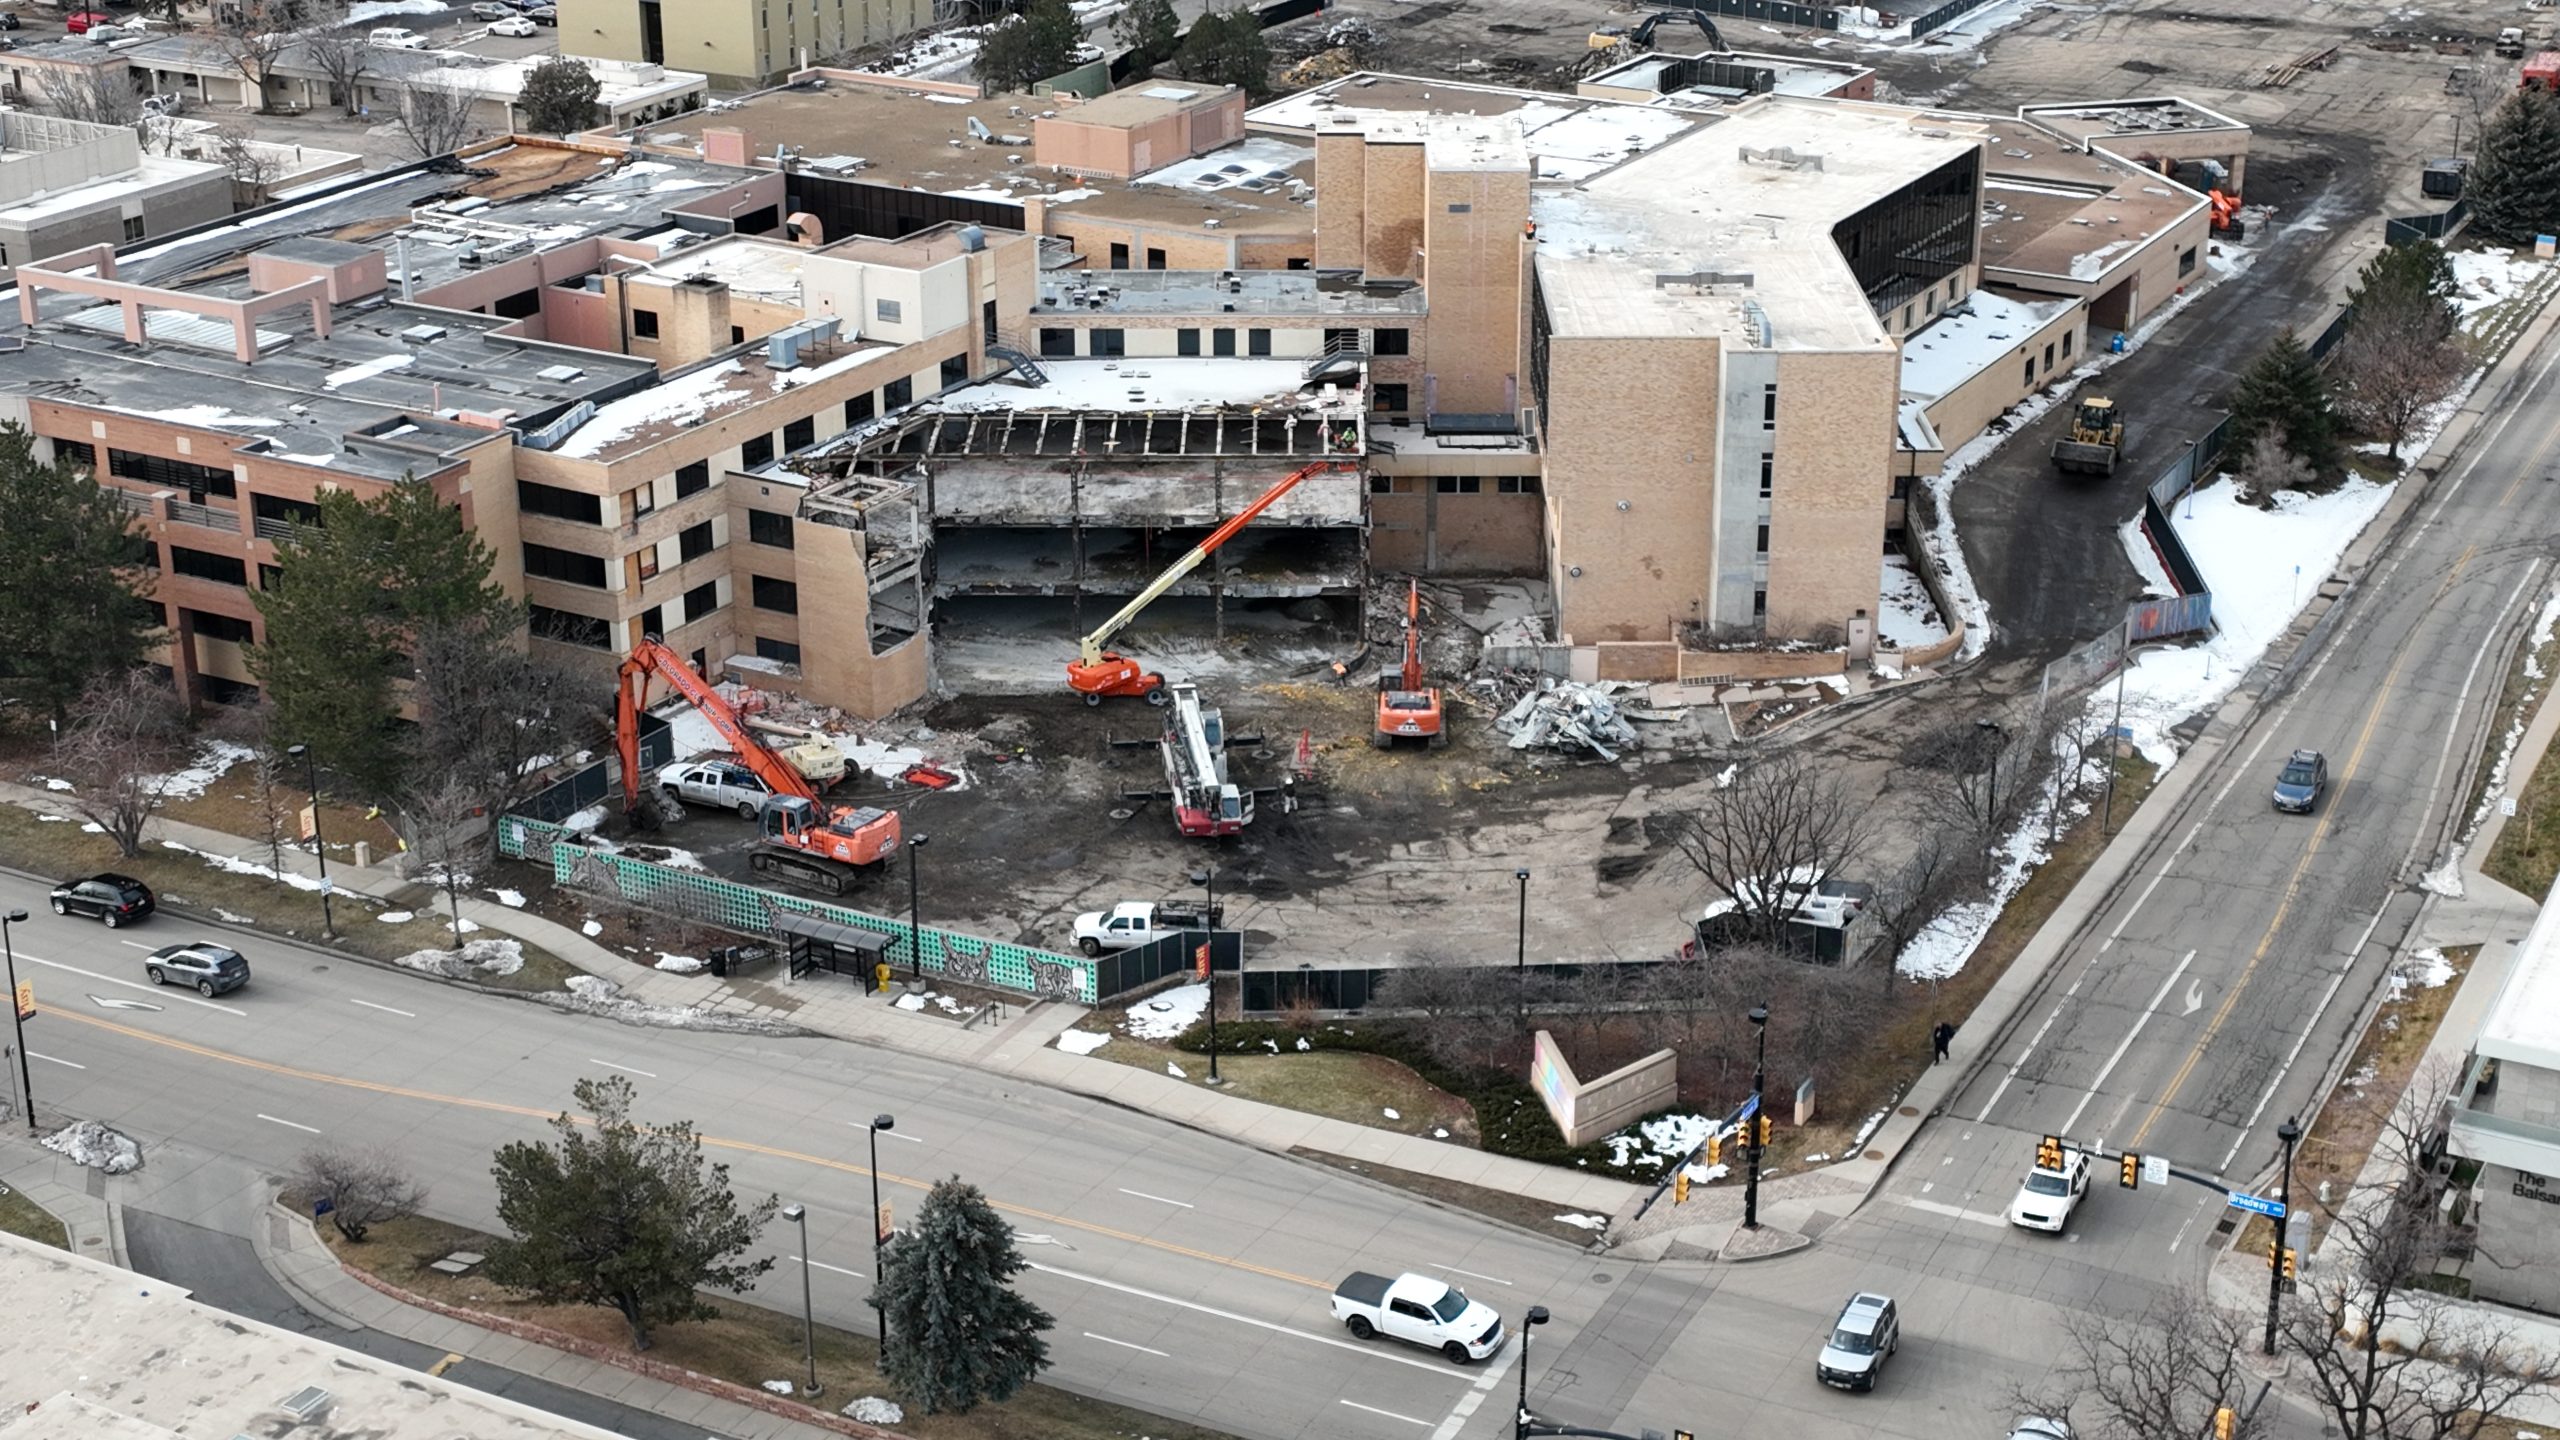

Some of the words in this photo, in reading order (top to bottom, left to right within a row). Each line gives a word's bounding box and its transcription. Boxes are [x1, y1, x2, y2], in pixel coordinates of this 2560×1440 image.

[657, 655, 691, 690] COLORADO
[689, 689, 717, 717] CLENUP
[2515, 1169, 2546, 1187] The
[2230, 1193, 2269, 1213] Broadway
